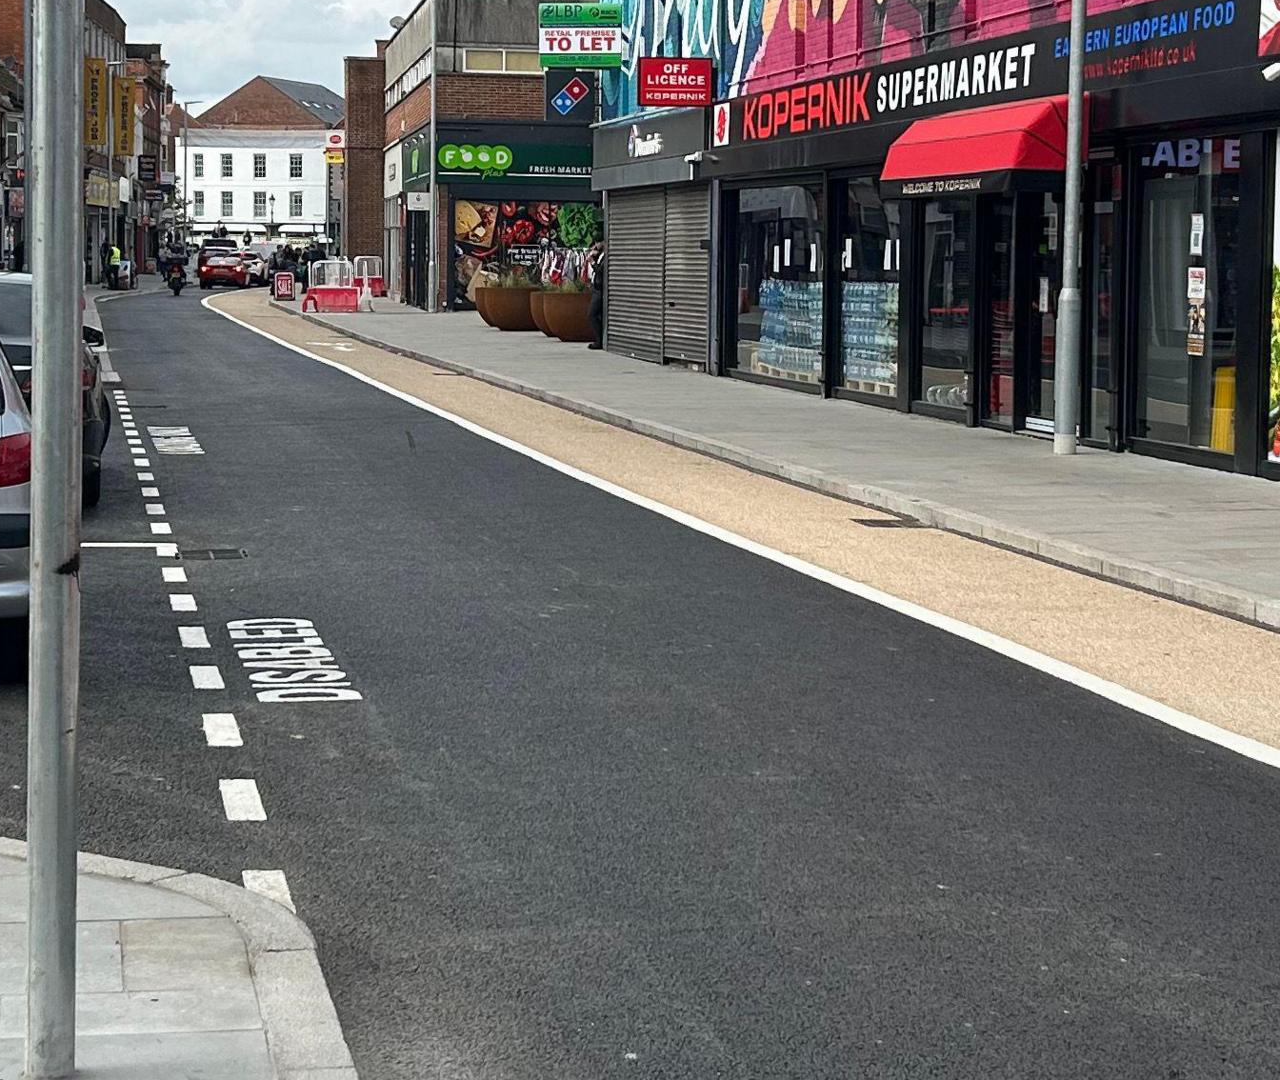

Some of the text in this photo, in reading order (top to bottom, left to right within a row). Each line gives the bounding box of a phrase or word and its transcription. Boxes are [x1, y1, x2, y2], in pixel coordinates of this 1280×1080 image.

[555, 5, 583, 18] LBP
[1054, 1, 1235, 58] EAERN EUROPEAN FOOD
[545, 37, 616, 51] TO LET
[663, 64, 689, 74] OFF
[647, 75, 705, 85] LICENCE
[876, 43, 1036, 113] SUPERMARKET
[646, 92, 706, 101] KOPERNIK
[743, 72, 872, 141] KOPERNIK
[558, 166, 592, 174] MARKET
[902, 181, 934, 195] WELCOME
[934, 180, 945, 192] TO
[226, 618, 363, 703] DISABLED
